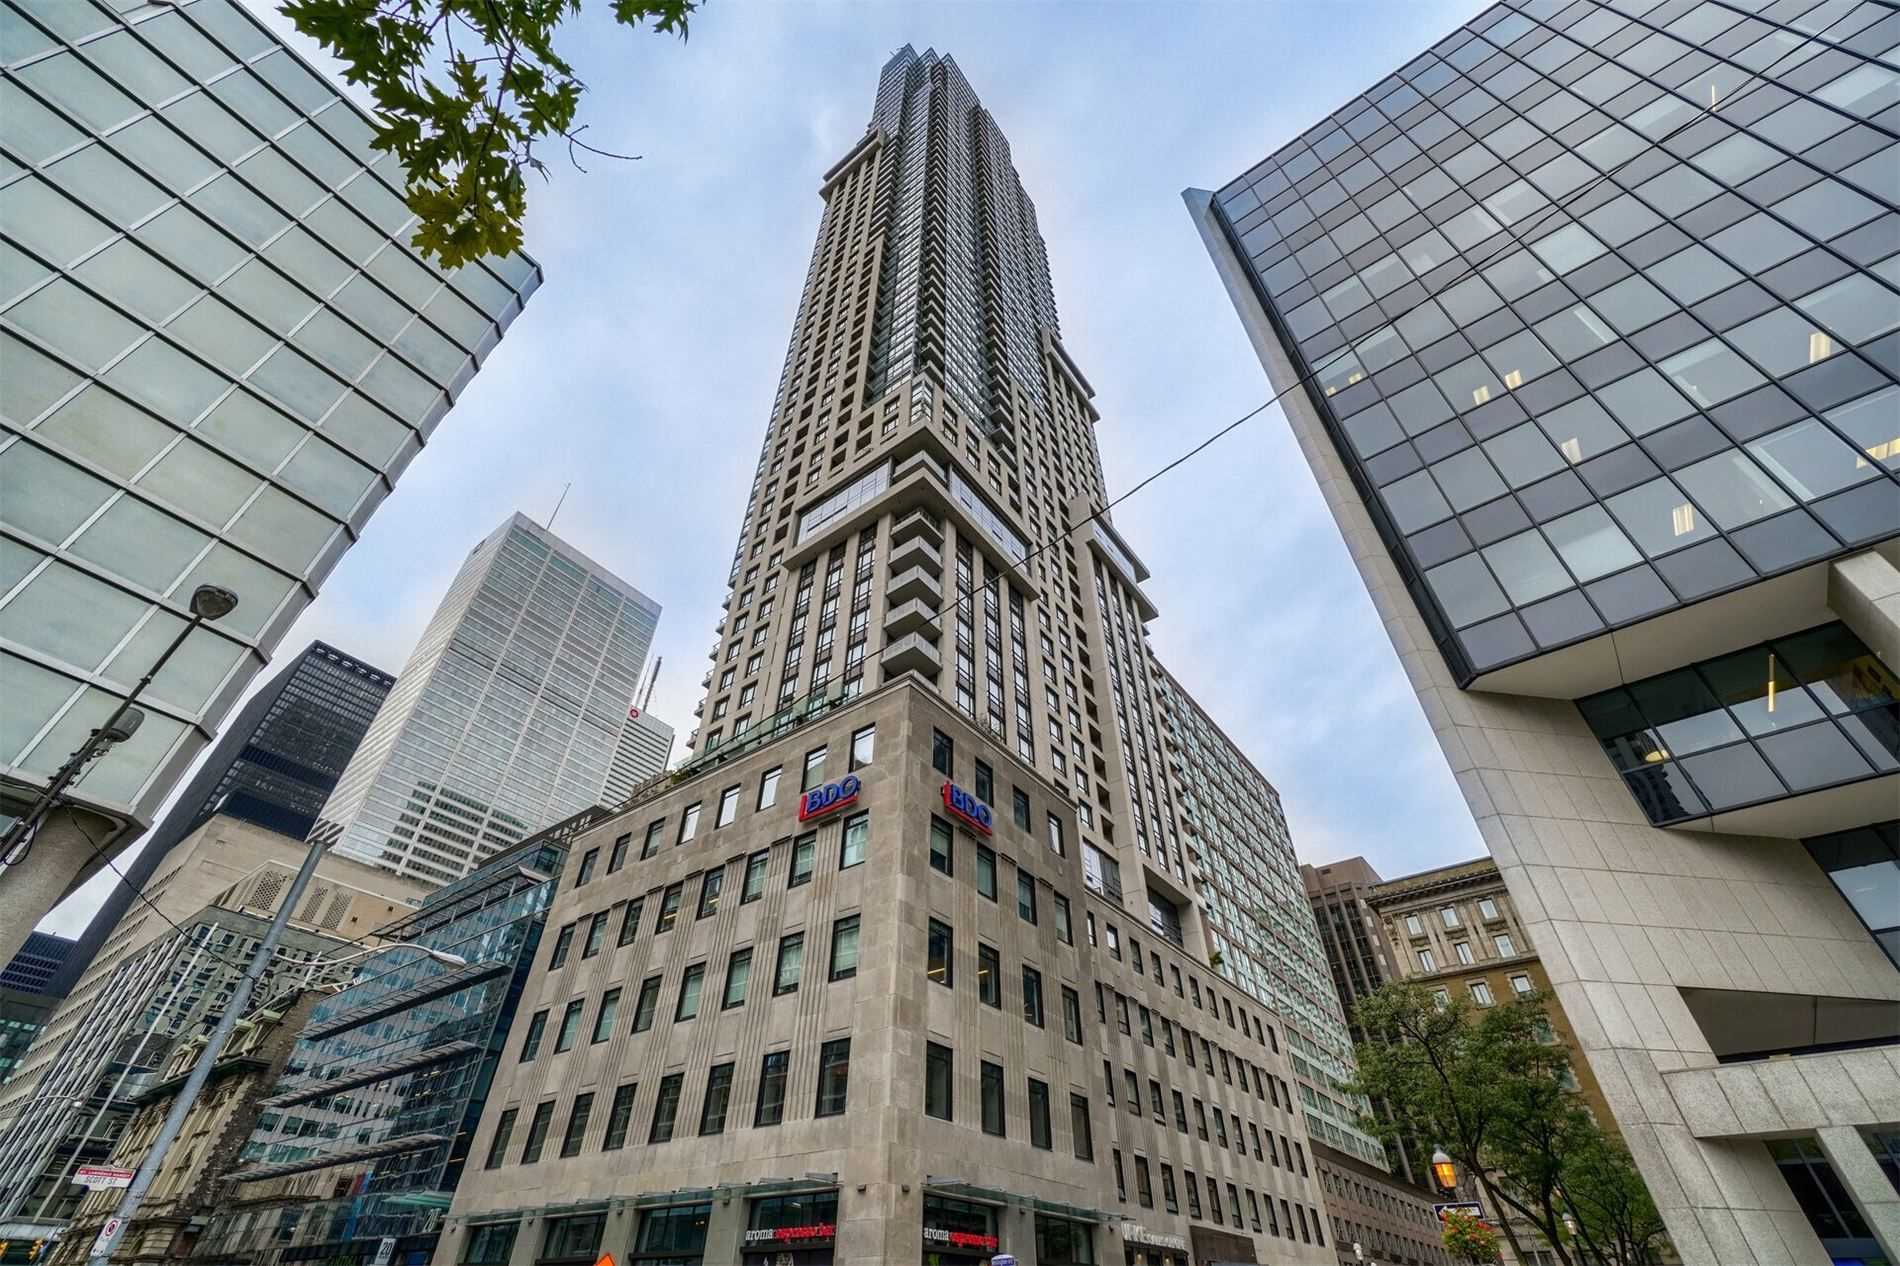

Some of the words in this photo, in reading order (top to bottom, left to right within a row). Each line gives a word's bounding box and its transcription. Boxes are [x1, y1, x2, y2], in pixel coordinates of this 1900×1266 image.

[807, 775, 861, 814] BDO
[950, 783, 993, 829] BDO
[745, 1229, 774, 1241] aroma
[924, 1227, 949, 1241] aroma
[381, 1242, 394, 1256] 20
